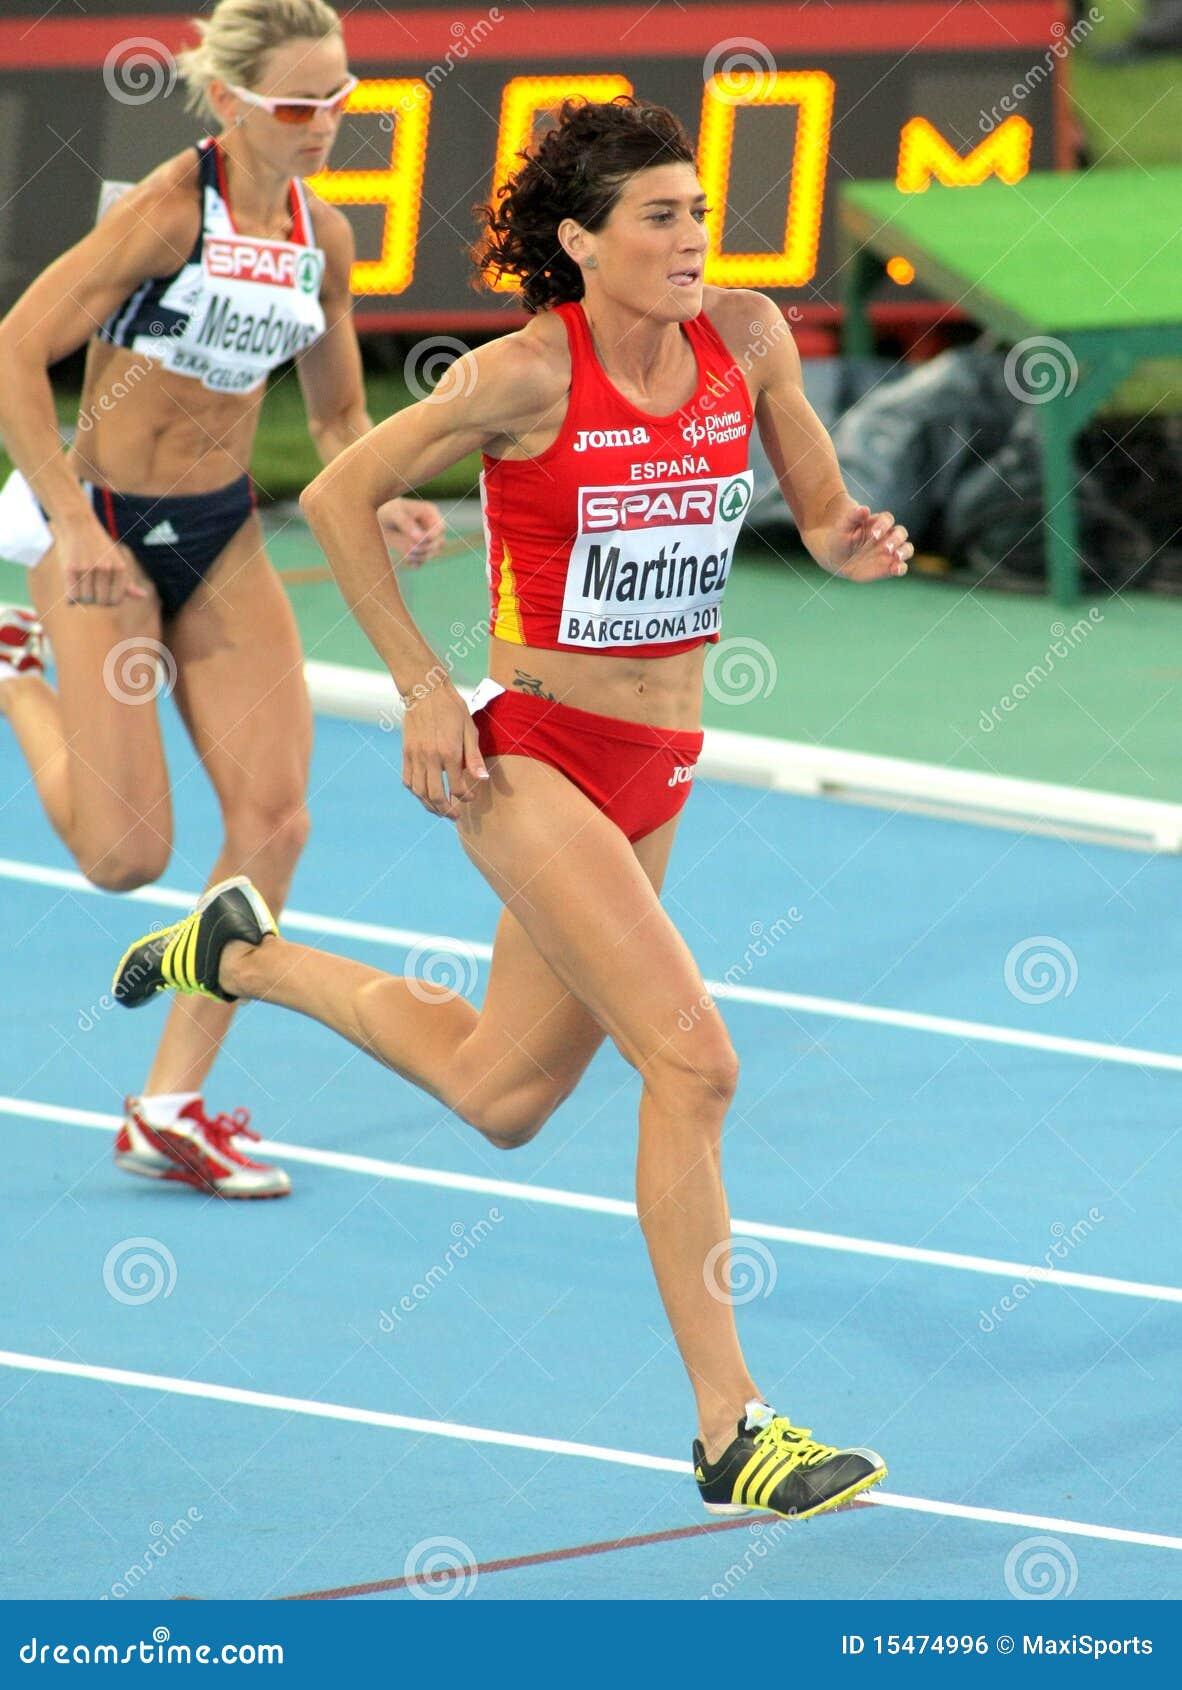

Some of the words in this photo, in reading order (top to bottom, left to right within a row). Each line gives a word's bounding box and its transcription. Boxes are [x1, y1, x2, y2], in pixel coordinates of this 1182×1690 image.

[705, 410, 741, 431] Divina
[707, 423, 747, 446] Pastora
[630, 454, 711, 481] ESPAÑA
[586, 490, 713, 529] SPAR
[582, 542, 728, 602] Martínez
[567, 615, 686, 642] BARCELONA
[693, 607, 720, 633] 201
